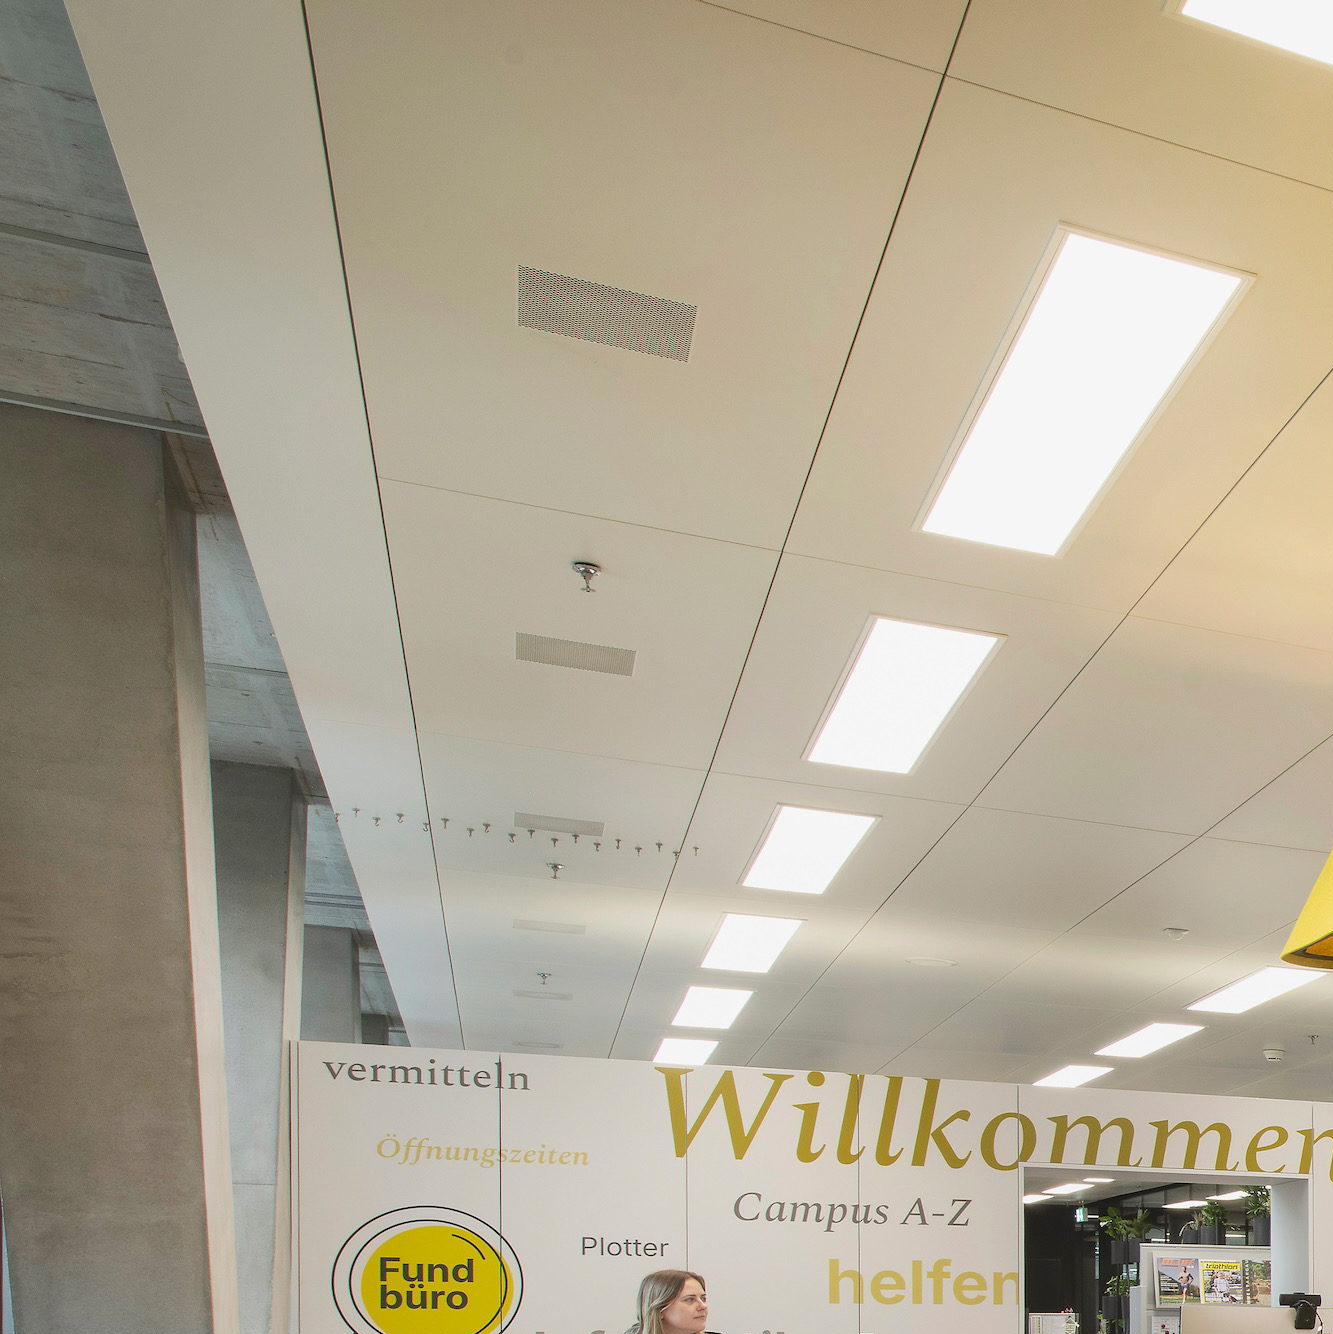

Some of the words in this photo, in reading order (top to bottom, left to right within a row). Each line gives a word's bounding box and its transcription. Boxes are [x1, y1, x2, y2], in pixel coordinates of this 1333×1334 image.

[322, 1058, 532, 1092] vermitteln
[375, 1132, 591, 1170] Öffnungszeiten
[733, 1191, 889, 1234] Campus
[900, 1197, 973, 1228] A-Z
[581, 1235, 670, 1258] Plotter
[379, 1256, 475, 1284] Fund
[827, 1257, 1020, 1306] helfen
[379, 1283, 470, 1311] büro
